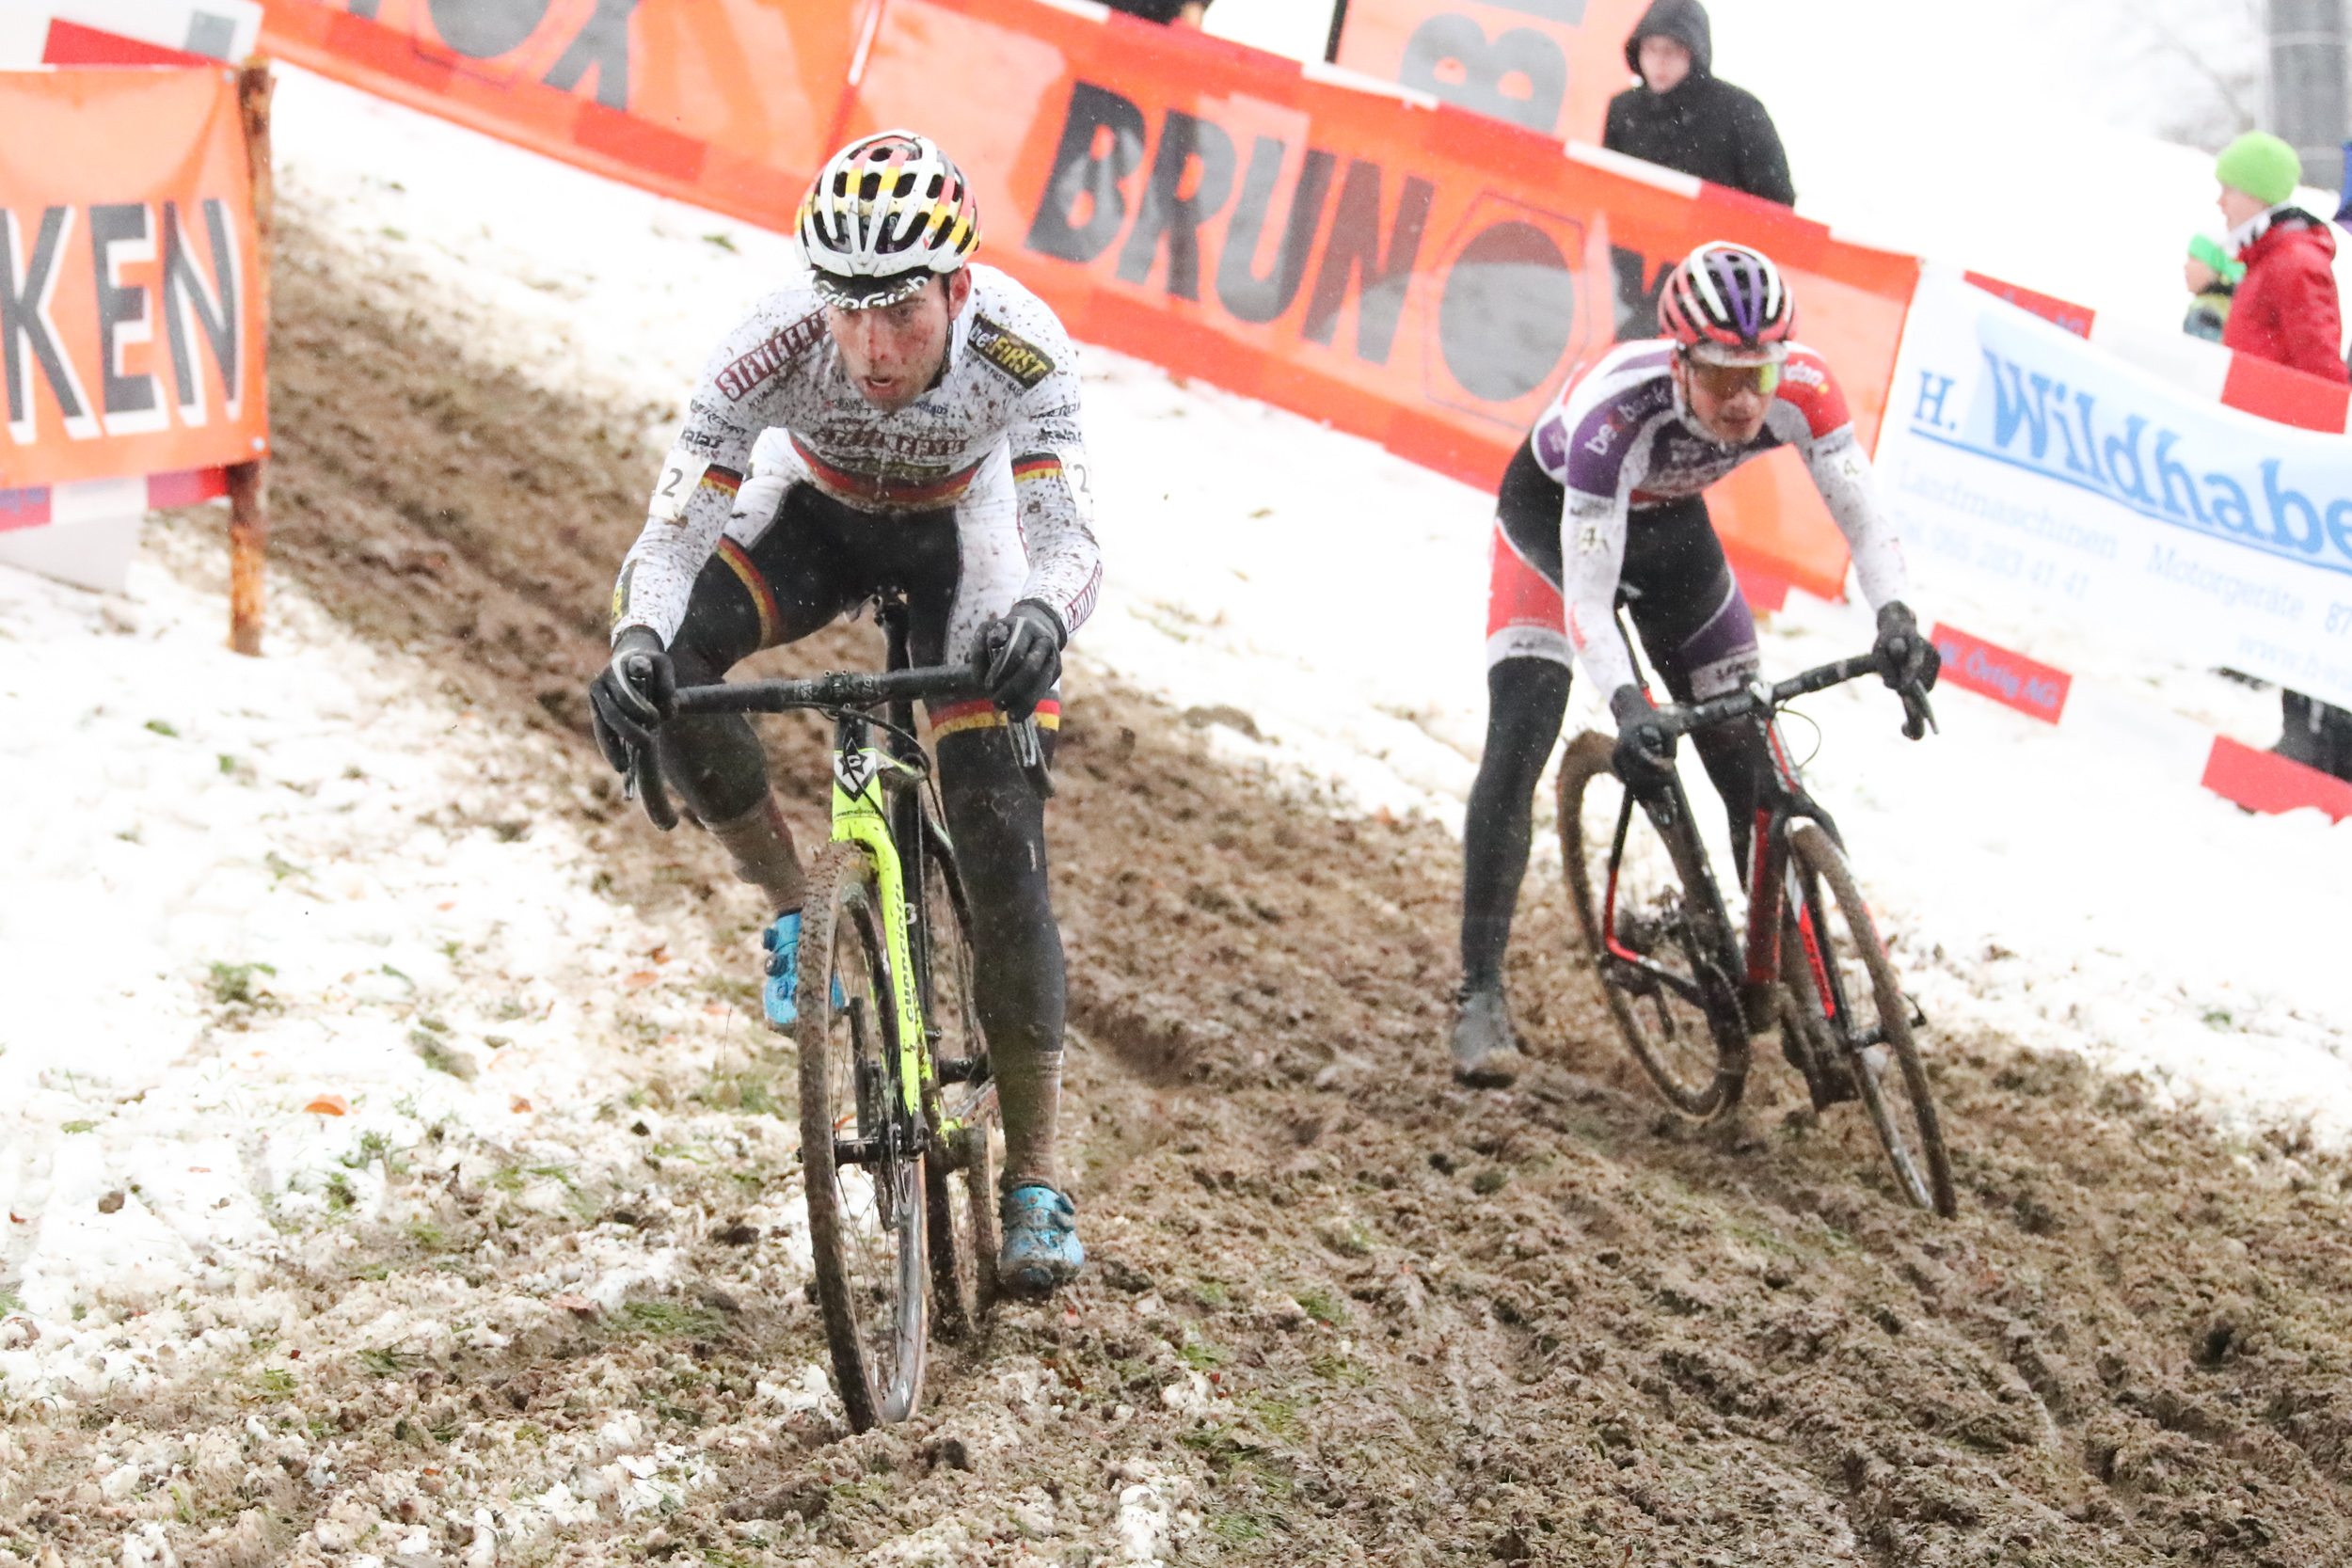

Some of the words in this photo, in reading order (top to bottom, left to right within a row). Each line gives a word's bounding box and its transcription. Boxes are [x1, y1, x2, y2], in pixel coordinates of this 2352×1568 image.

[1912, 371, 1957, 431] H.
[661, 467, 683, 498] 2
[1073, 464, 1090, 493] 2
[1899, 460, 2117, 561] Landmaschinen
